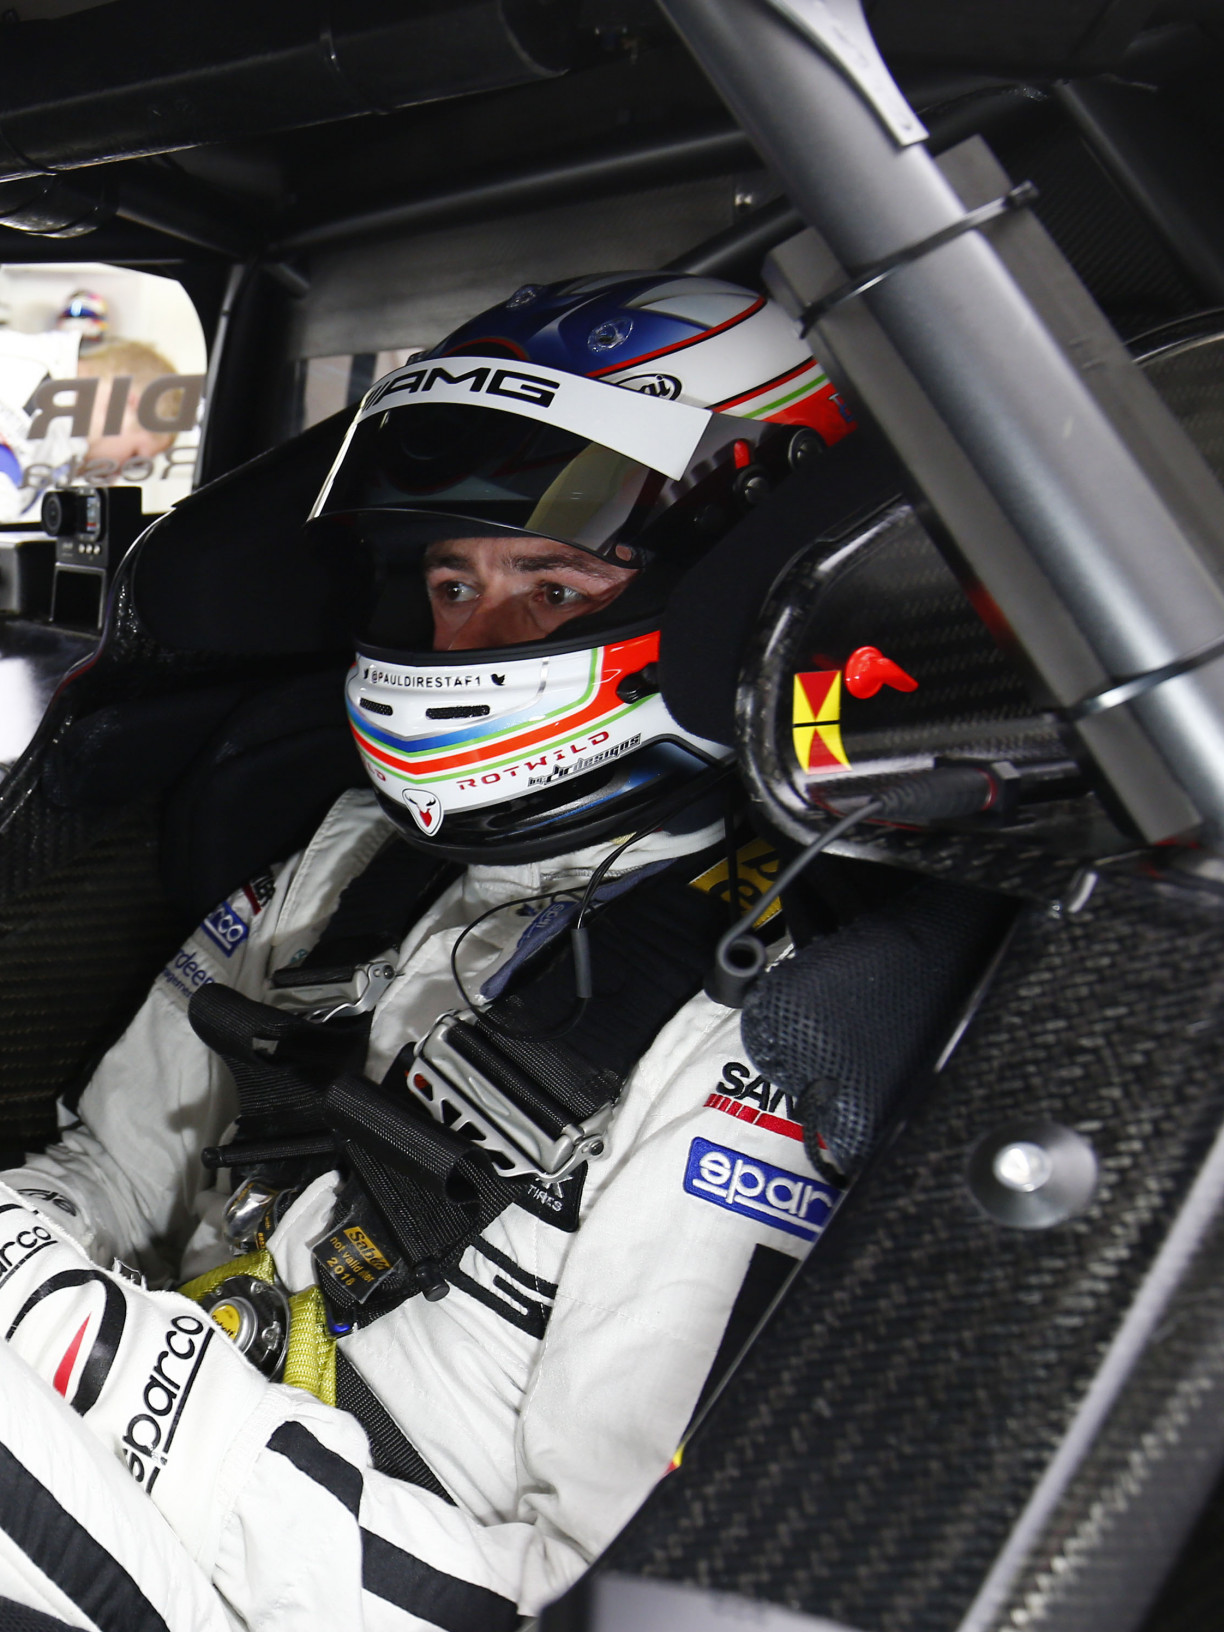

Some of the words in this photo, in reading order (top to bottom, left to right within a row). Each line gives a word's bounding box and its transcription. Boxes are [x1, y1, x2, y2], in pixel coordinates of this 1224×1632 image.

[372, 367, 560, 408] AMG
[716, 1061, 797, 1121] SAN
[528, 1185, 563, 1212] TIRES
[699, 1151, 833, 1218] spar
[326, 1257, 356, 1286] 2018
[329, 1236, 347, 1253] not
[342, 1251, 364, 1273] valid
